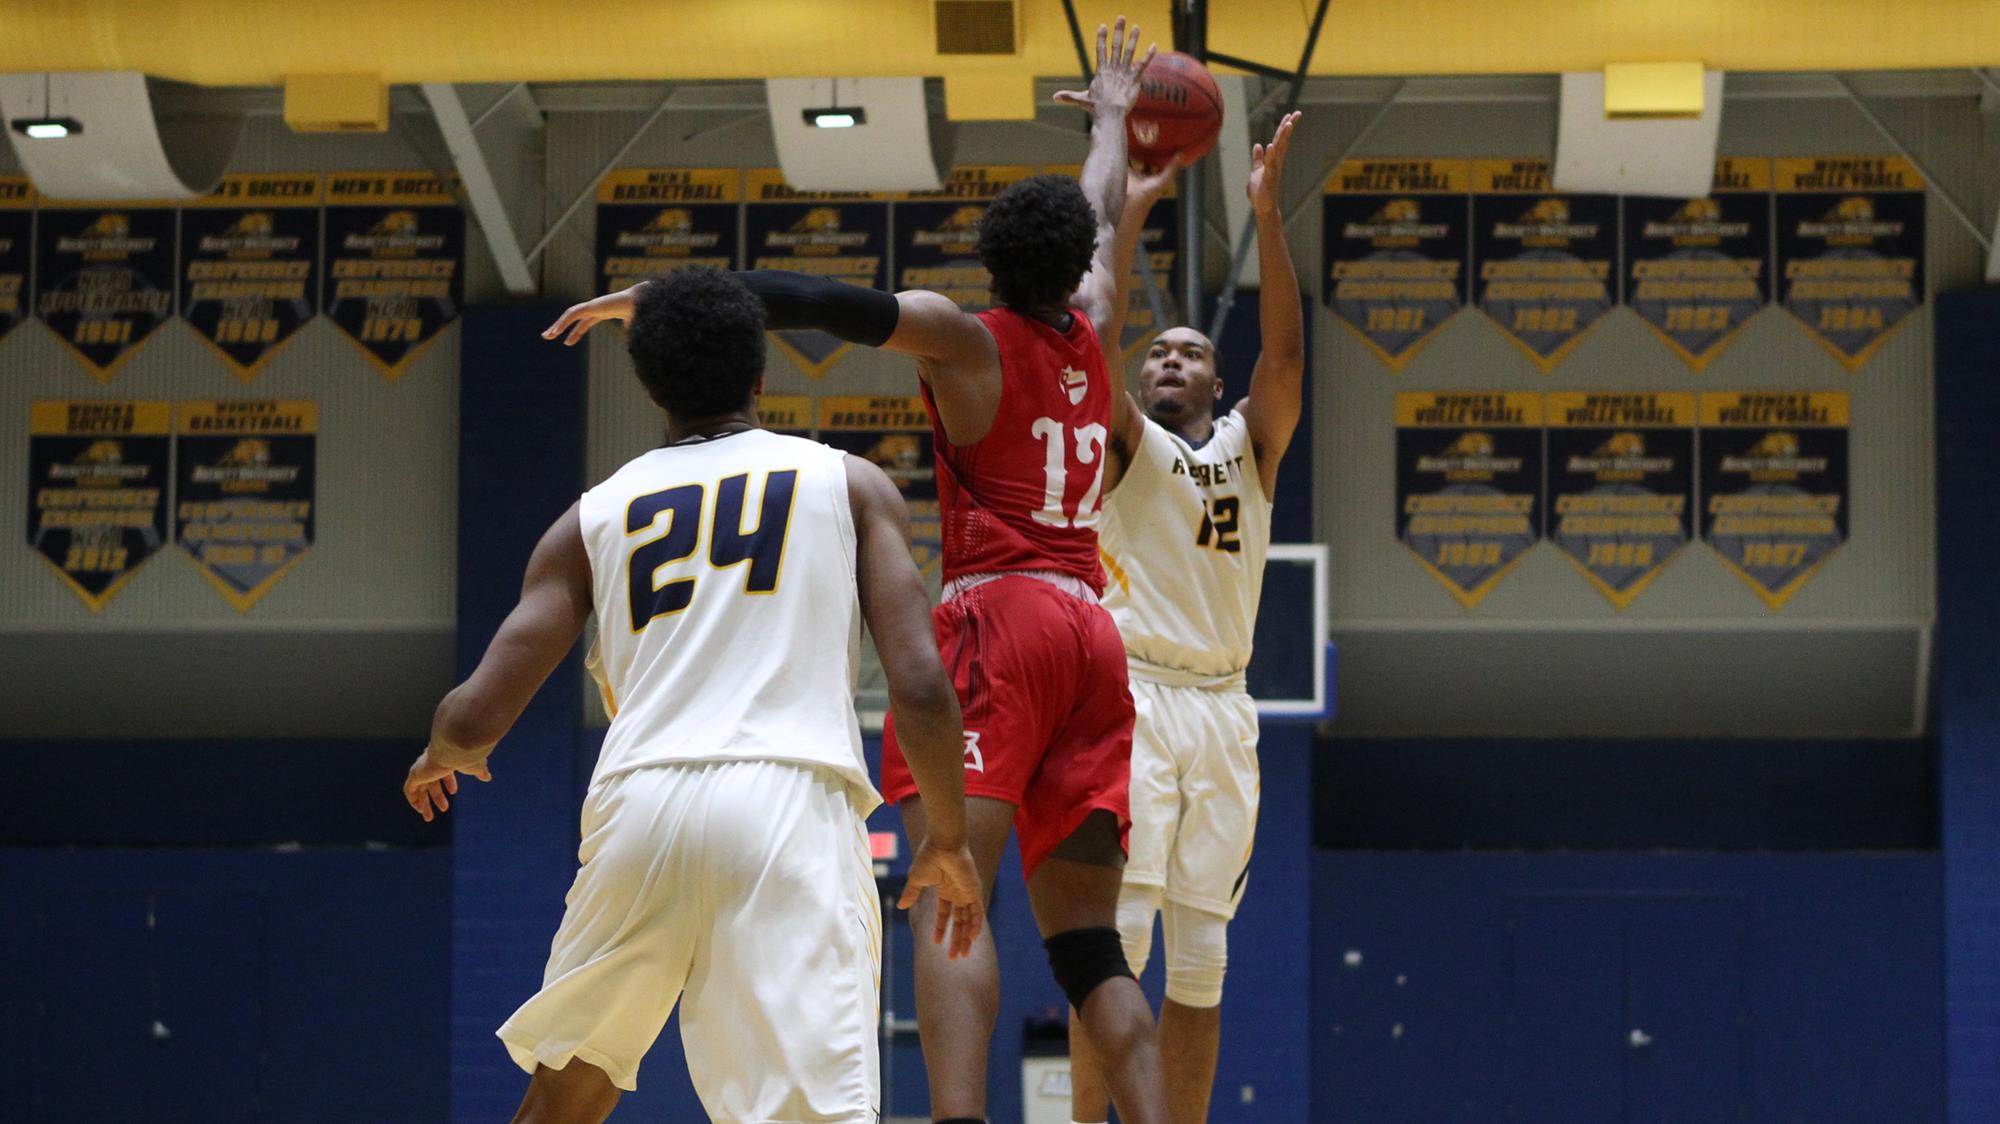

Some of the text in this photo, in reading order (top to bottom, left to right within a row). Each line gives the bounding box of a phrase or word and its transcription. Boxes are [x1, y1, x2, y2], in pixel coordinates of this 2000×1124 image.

[613, 185, 723, 200] BASKETBALL
[189, 415, 301, 430] BASKETBALL
[831, 412, 927, 425] BASKETBA
[1031, 417, 1107, 528] 12
[1172, 456, 1243, 487] AERETT
[1195, 495, 1241, 554] 12
[624, 469, 800, 635] 24
